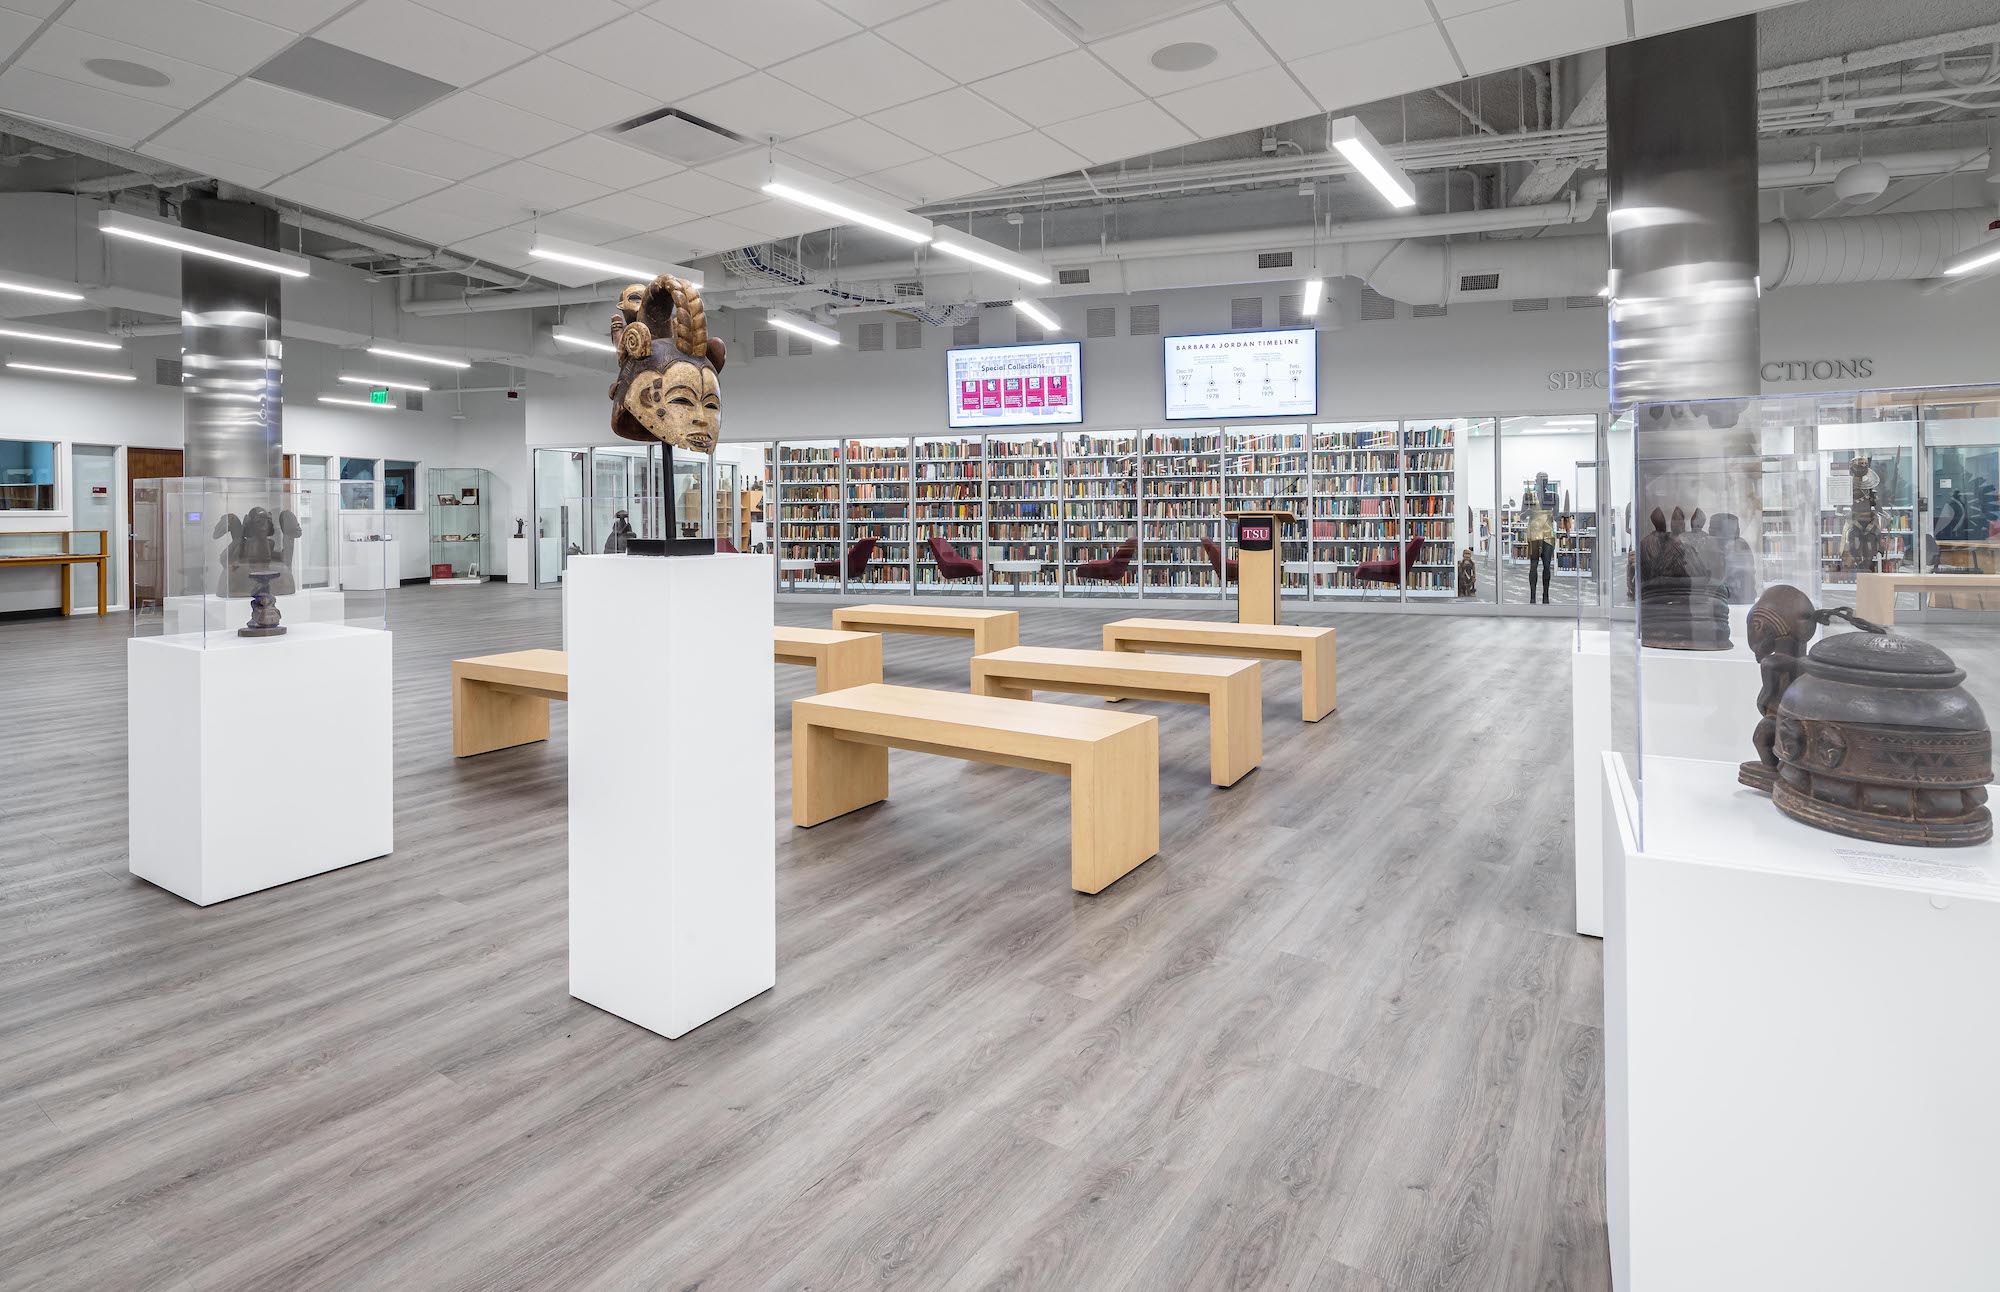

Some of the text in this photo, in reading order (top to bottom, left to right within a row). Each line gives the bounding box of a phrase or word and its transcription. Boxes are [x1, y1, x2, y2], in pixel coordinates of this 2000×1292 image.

[1176, 338, 1299, 351] BARBARA JORDAN TIMELINE
[981, 362, 1045, 373] Special Collections
[1548, 358, 1873, 391] SPEC CTIONS
[1243, 529, 1269, 539] TSU
